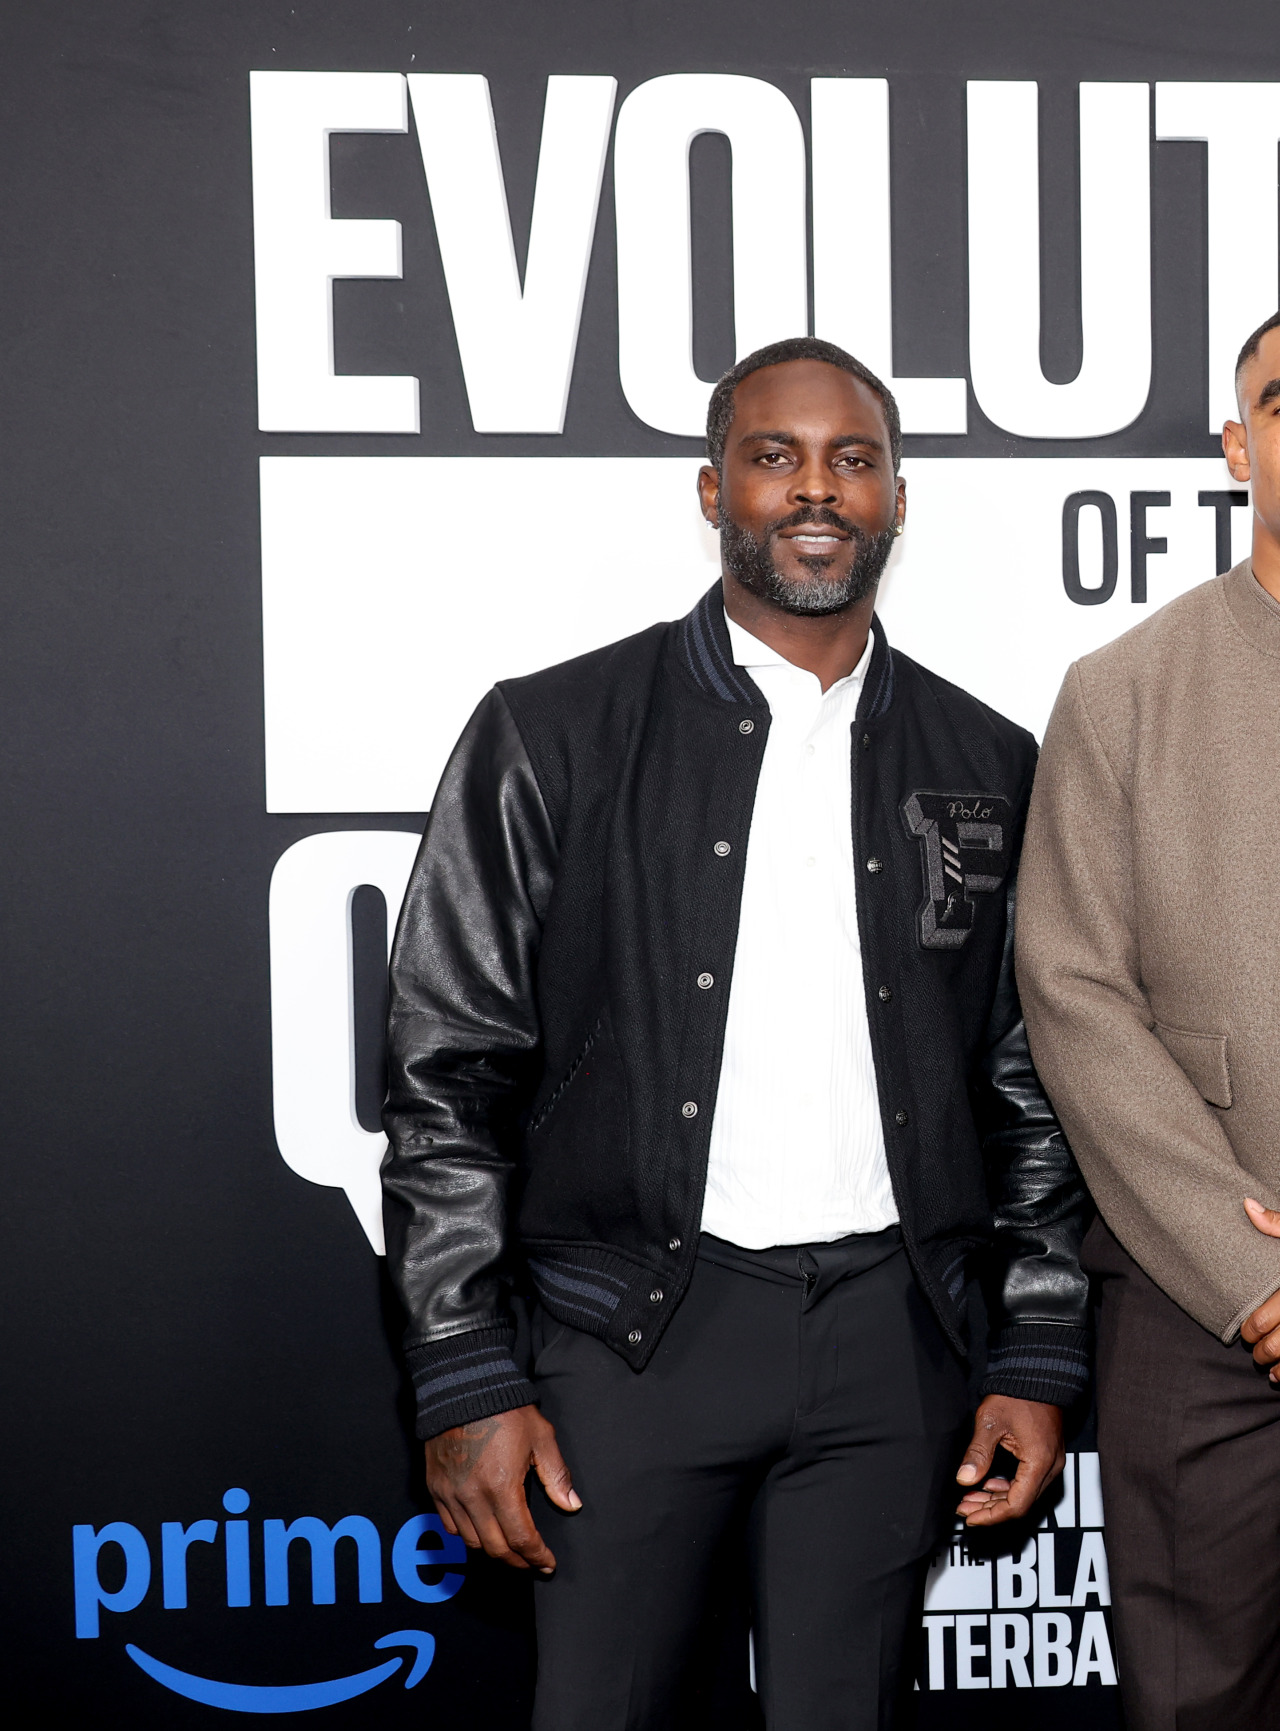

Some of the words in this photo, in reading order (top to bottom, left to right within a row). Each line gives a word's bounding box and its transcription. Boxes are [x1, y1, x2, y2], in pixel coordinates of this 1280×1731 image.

[1061, 490, 1171, 606] OF
[947, 800, 993, 819] Polo
[72, 1487, 467, 1639] prime
[997, 1531, 1111, 1609] BLA
